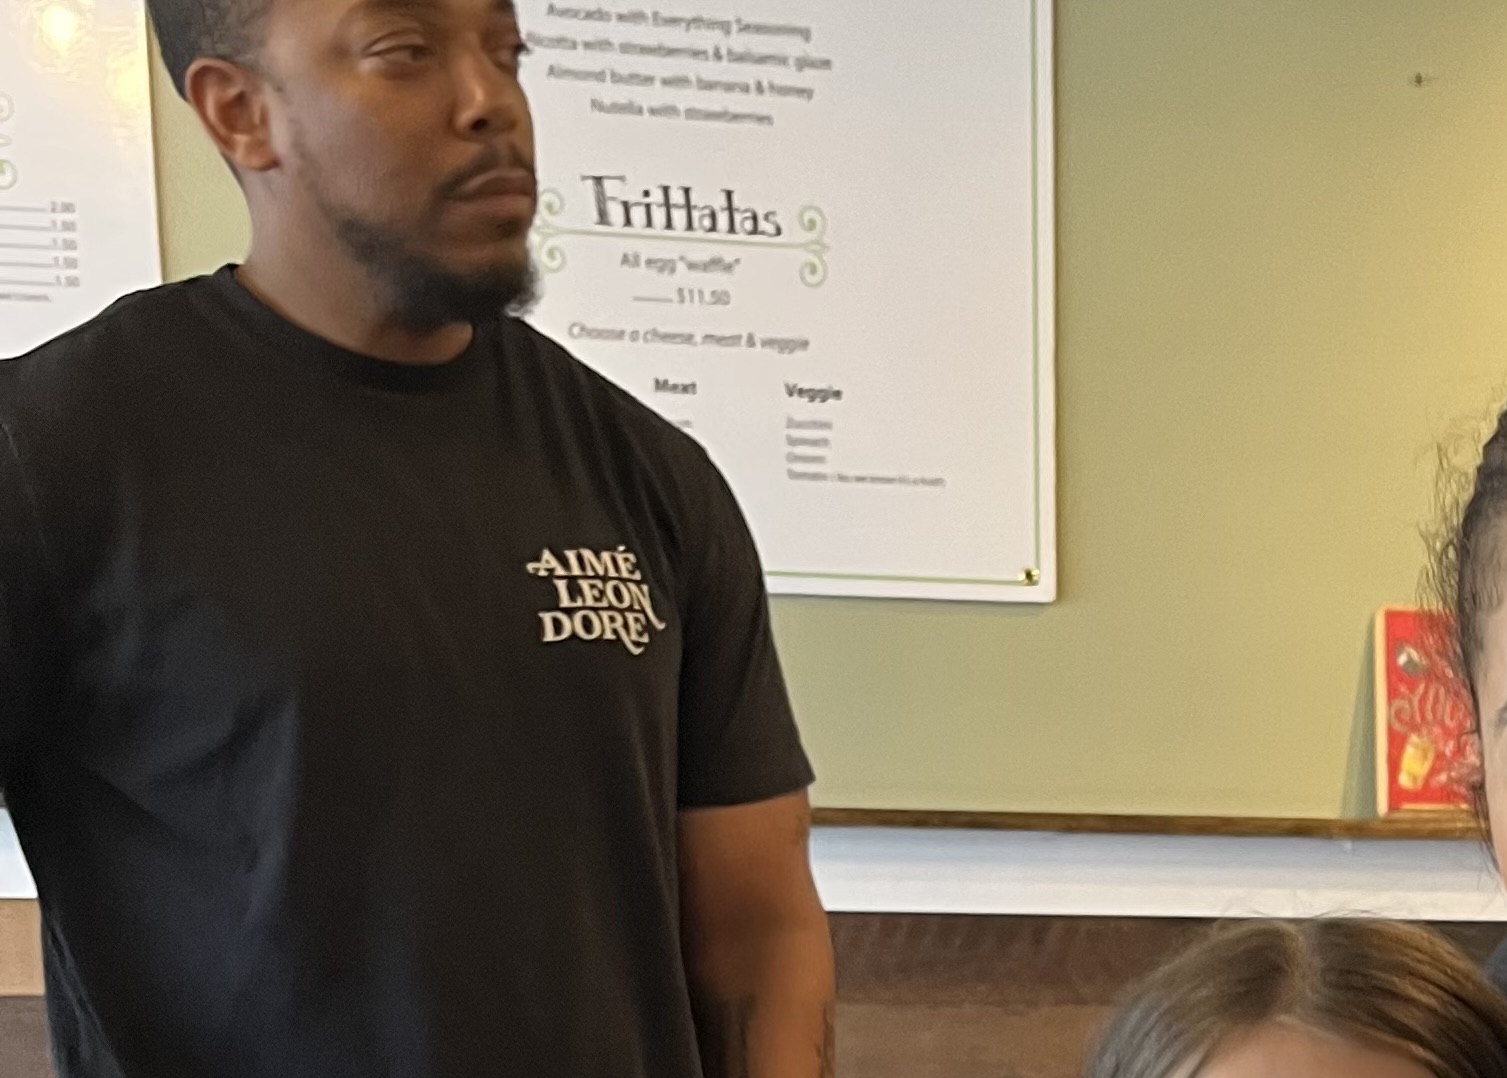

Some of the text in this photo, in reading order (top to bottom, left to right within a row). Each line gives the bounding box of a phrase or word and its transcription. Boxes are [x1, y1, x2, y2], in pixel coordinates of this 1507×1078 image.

[616, 9, 649, 25] with
[652, 11, 733, 37] Everything
[582, 38, 616, 52] with
[713, 45, 724, 62] &
[547, 64, 816, 102] Almond butter with banana & honey
[590, 98, 644, 116] Nutella
[647, 104, 682, 118] with
[580, 175, 782, 237] Frittatas
[644, 258, 677, 276] egg
[568, 322, 625, 341] Choose
[629, 330, 640, 343] a
[746, 332, 756, 349] &
[760, 338, 809, 354] veggie
[654, 377, 697, 395] Meat
[784, 382, 843, 403] Veggie
[526, 544, 642, 581] AIMÉ
[552, 578, 666, 630] LEON
[538, 609, 649, 656] DORE
